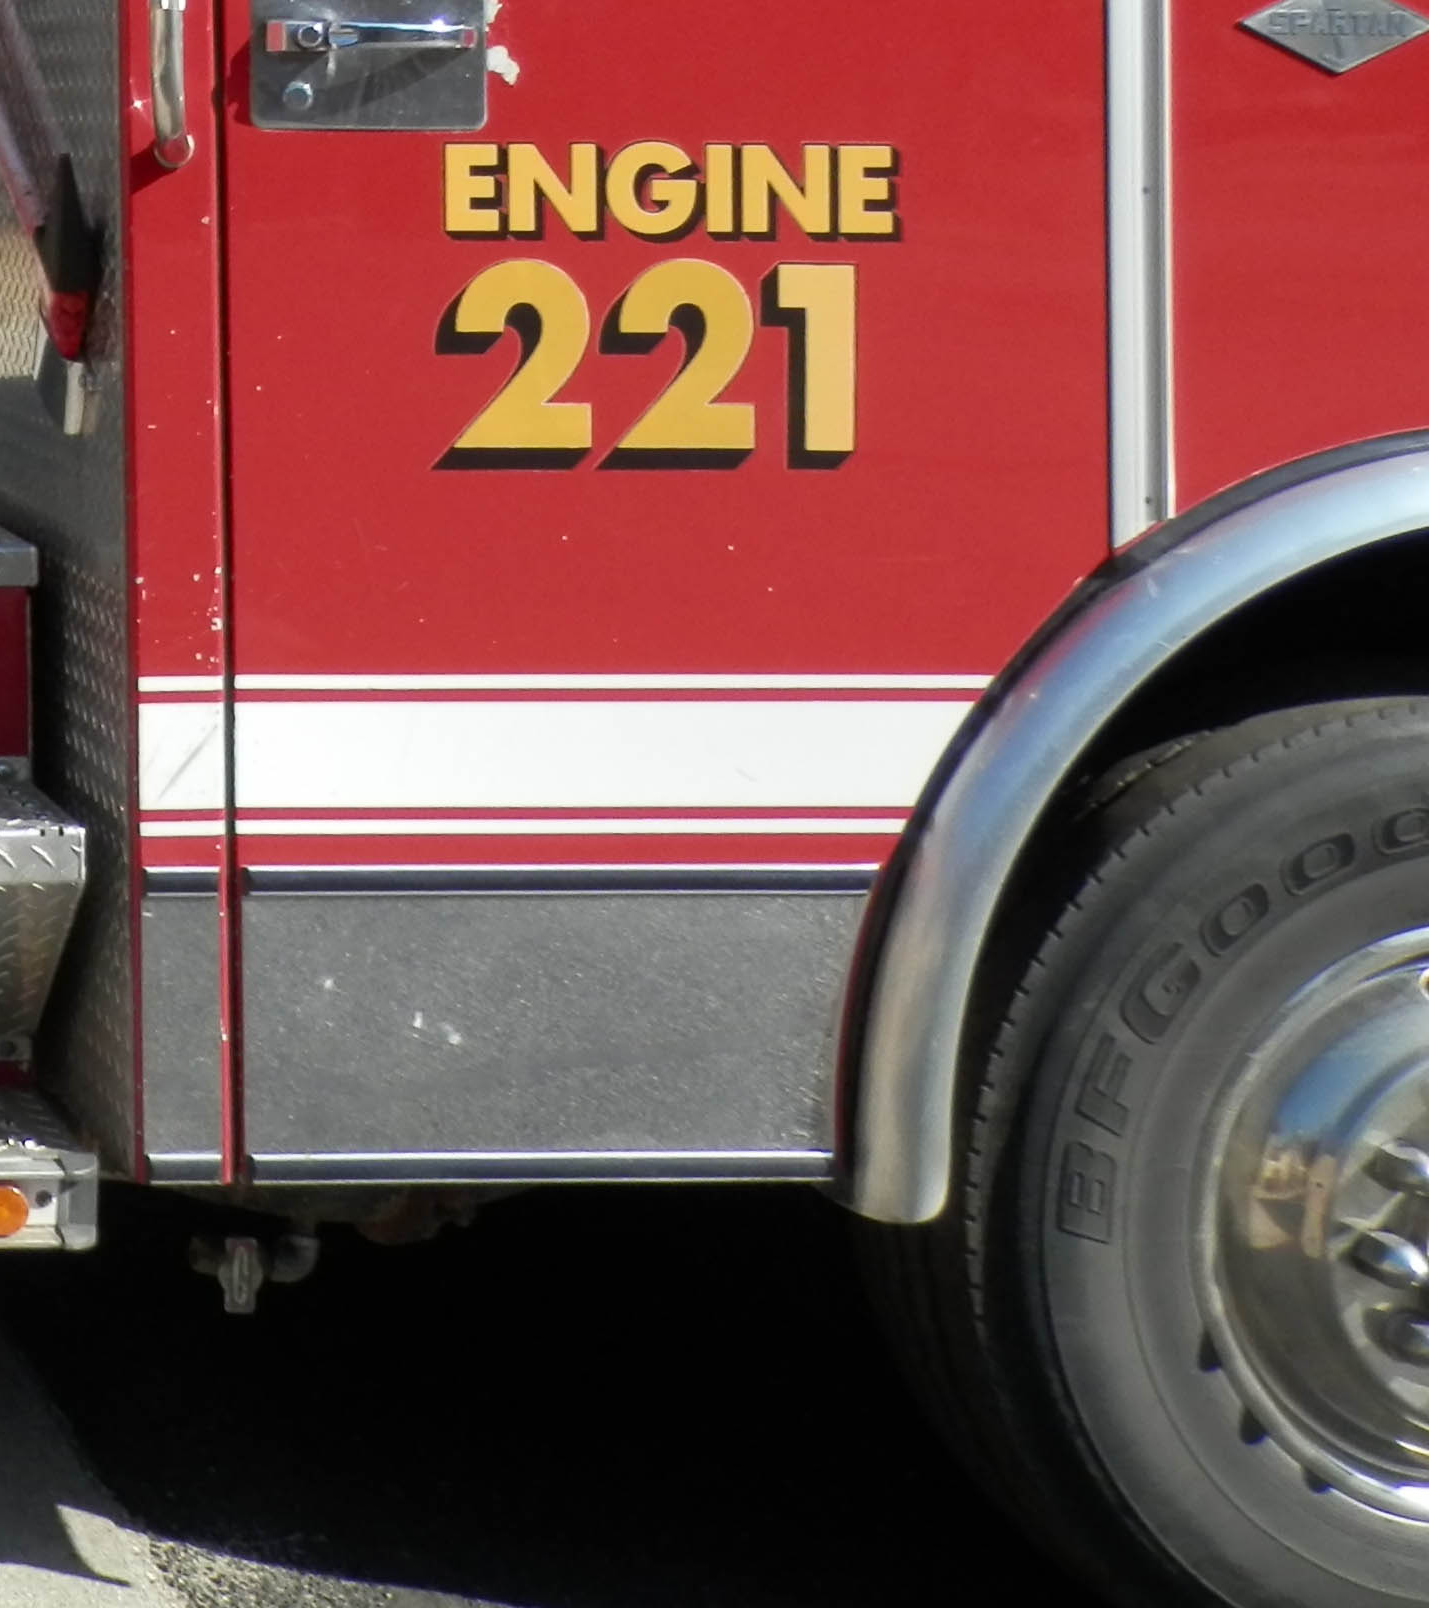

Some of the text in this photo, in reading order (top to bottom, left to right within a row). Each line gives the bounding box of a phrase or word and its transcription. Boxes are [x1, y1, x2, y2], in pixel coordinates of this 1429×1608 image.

[1268, 8, 1408, 38] SPARTAN
[444, 141, 900, 241] ENGINE
[431, 258, 858, 470] 221
